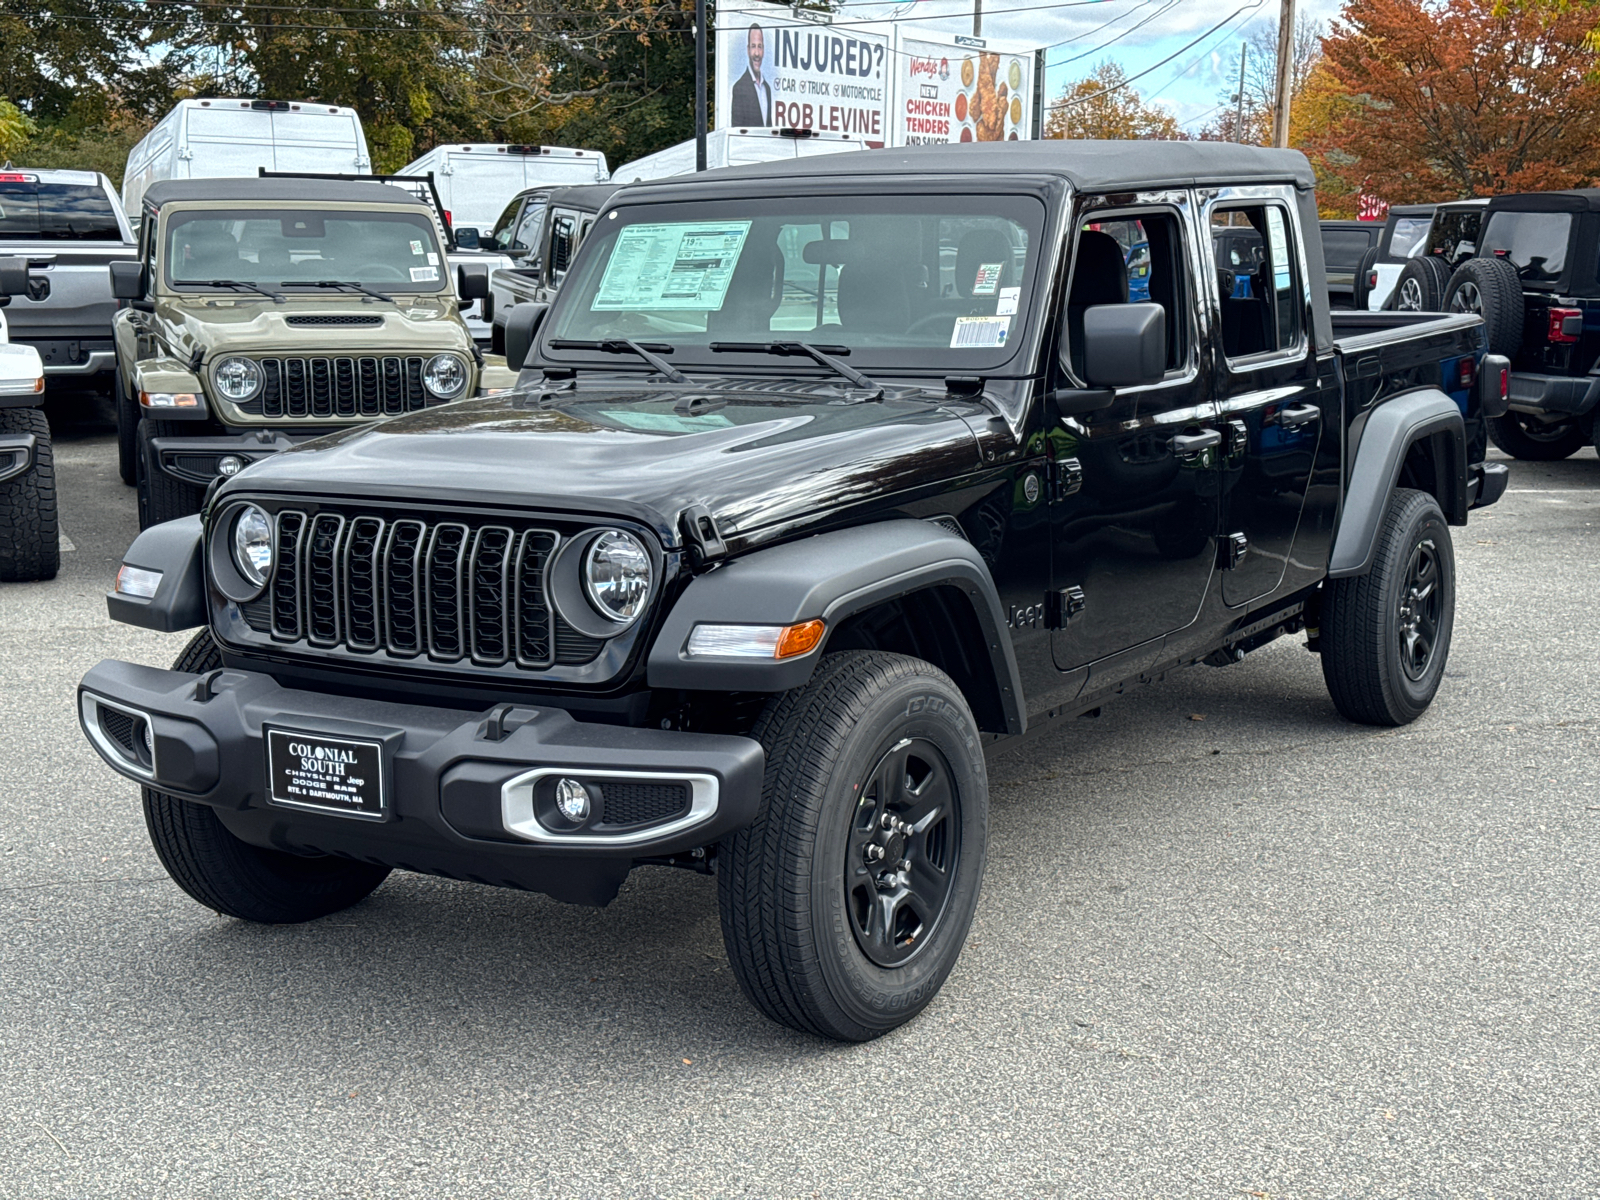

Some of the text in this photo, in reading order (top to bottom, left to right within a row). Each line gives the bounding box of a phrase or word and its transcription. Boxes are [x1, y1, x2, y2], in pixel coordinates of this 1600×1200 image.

[774, 28, 884, 79] INJURED?
[909, 54, 938, 79] Wendy's
[781, 77, 882, 101] CAR TRUCK MOTORCYCLE
[920, 85, 938, 98] NEW
[775, 100, 881, 135] ROB LEVINE
[906, 99, 951, 117] CHICKEN
[906, 117, 950, 135] TENDERS
[905, 134, 921, 147] AND
[905, 695, 986, 791] DUELER
[288, 742, 358, 764] COLONIAL
[301, 757, 346, 776] SOUTH
[284, 768, 365, 787] CHRYSLER Jeep
[292, 777, 327, 789] DODGE
[352, 795, 364, 804] MA
[829, 887, 941, 1011] BRIDGESTONE
